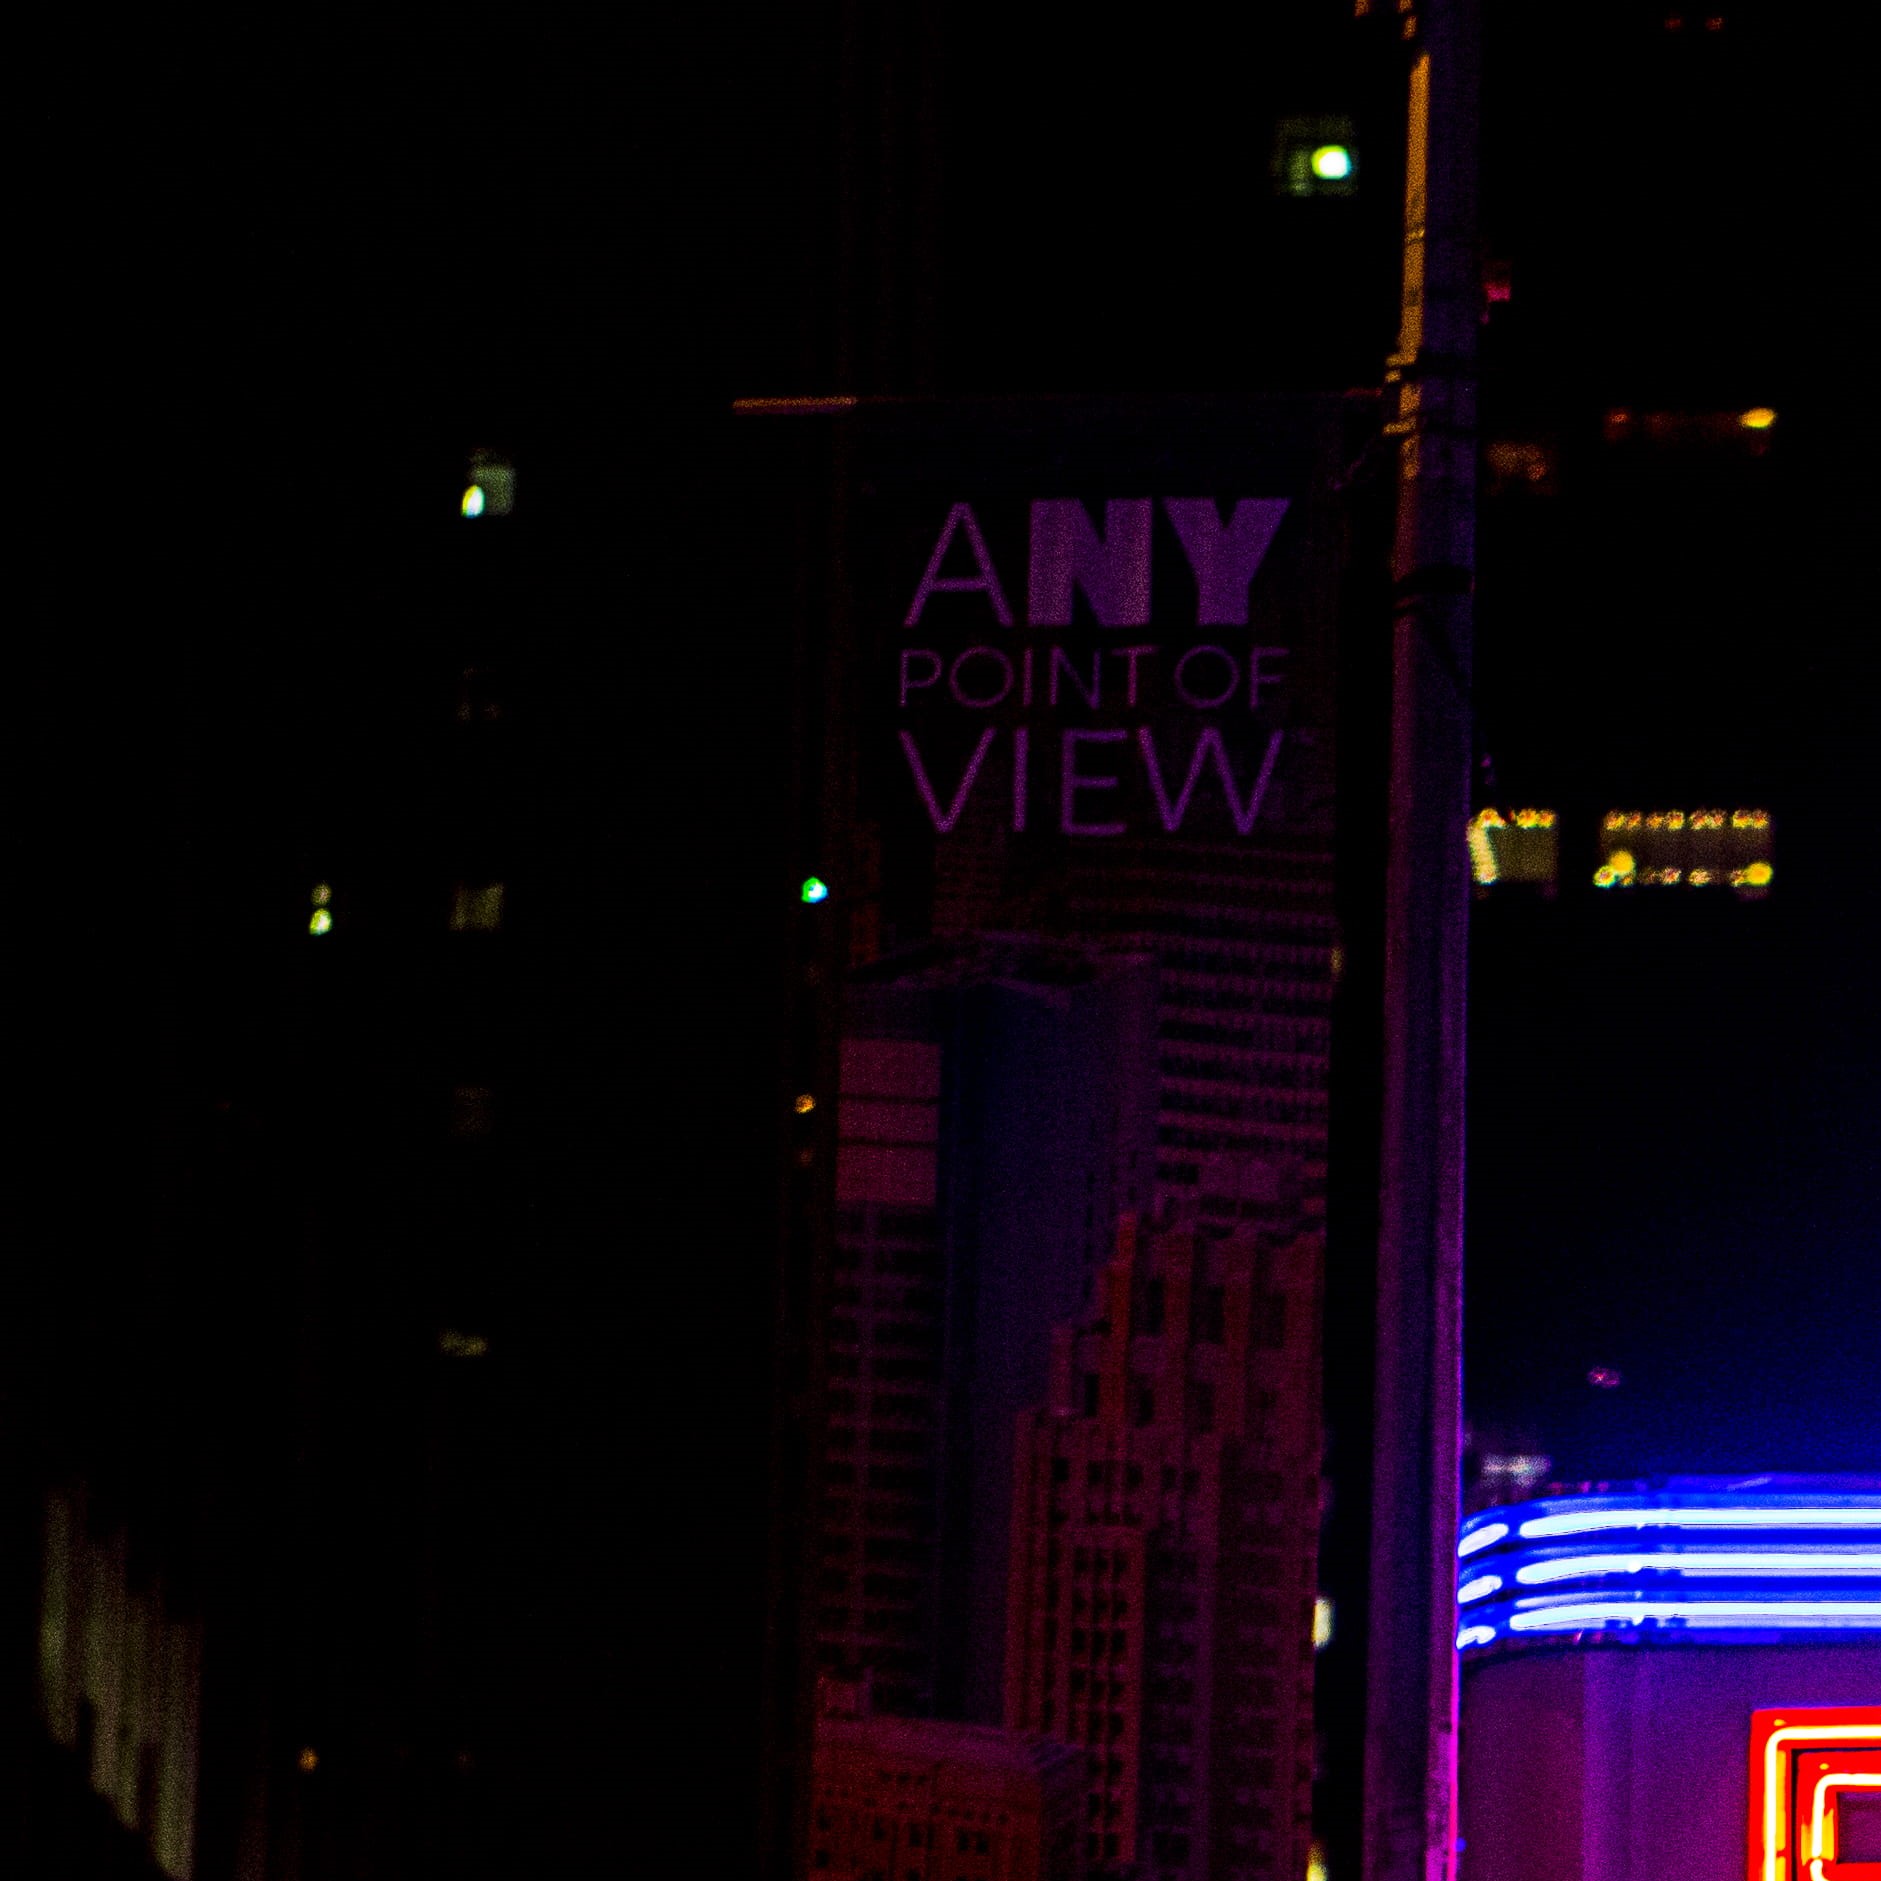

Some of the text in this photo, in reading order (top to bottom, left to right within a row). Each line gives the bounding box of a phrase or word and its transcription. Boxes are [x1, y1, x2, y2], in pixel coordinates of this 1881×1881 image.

[903, 496, 1294, 630] ANY
[899, 644, 1292, 711] POINT OF
[899, 726, 1288, 836] VIEW
